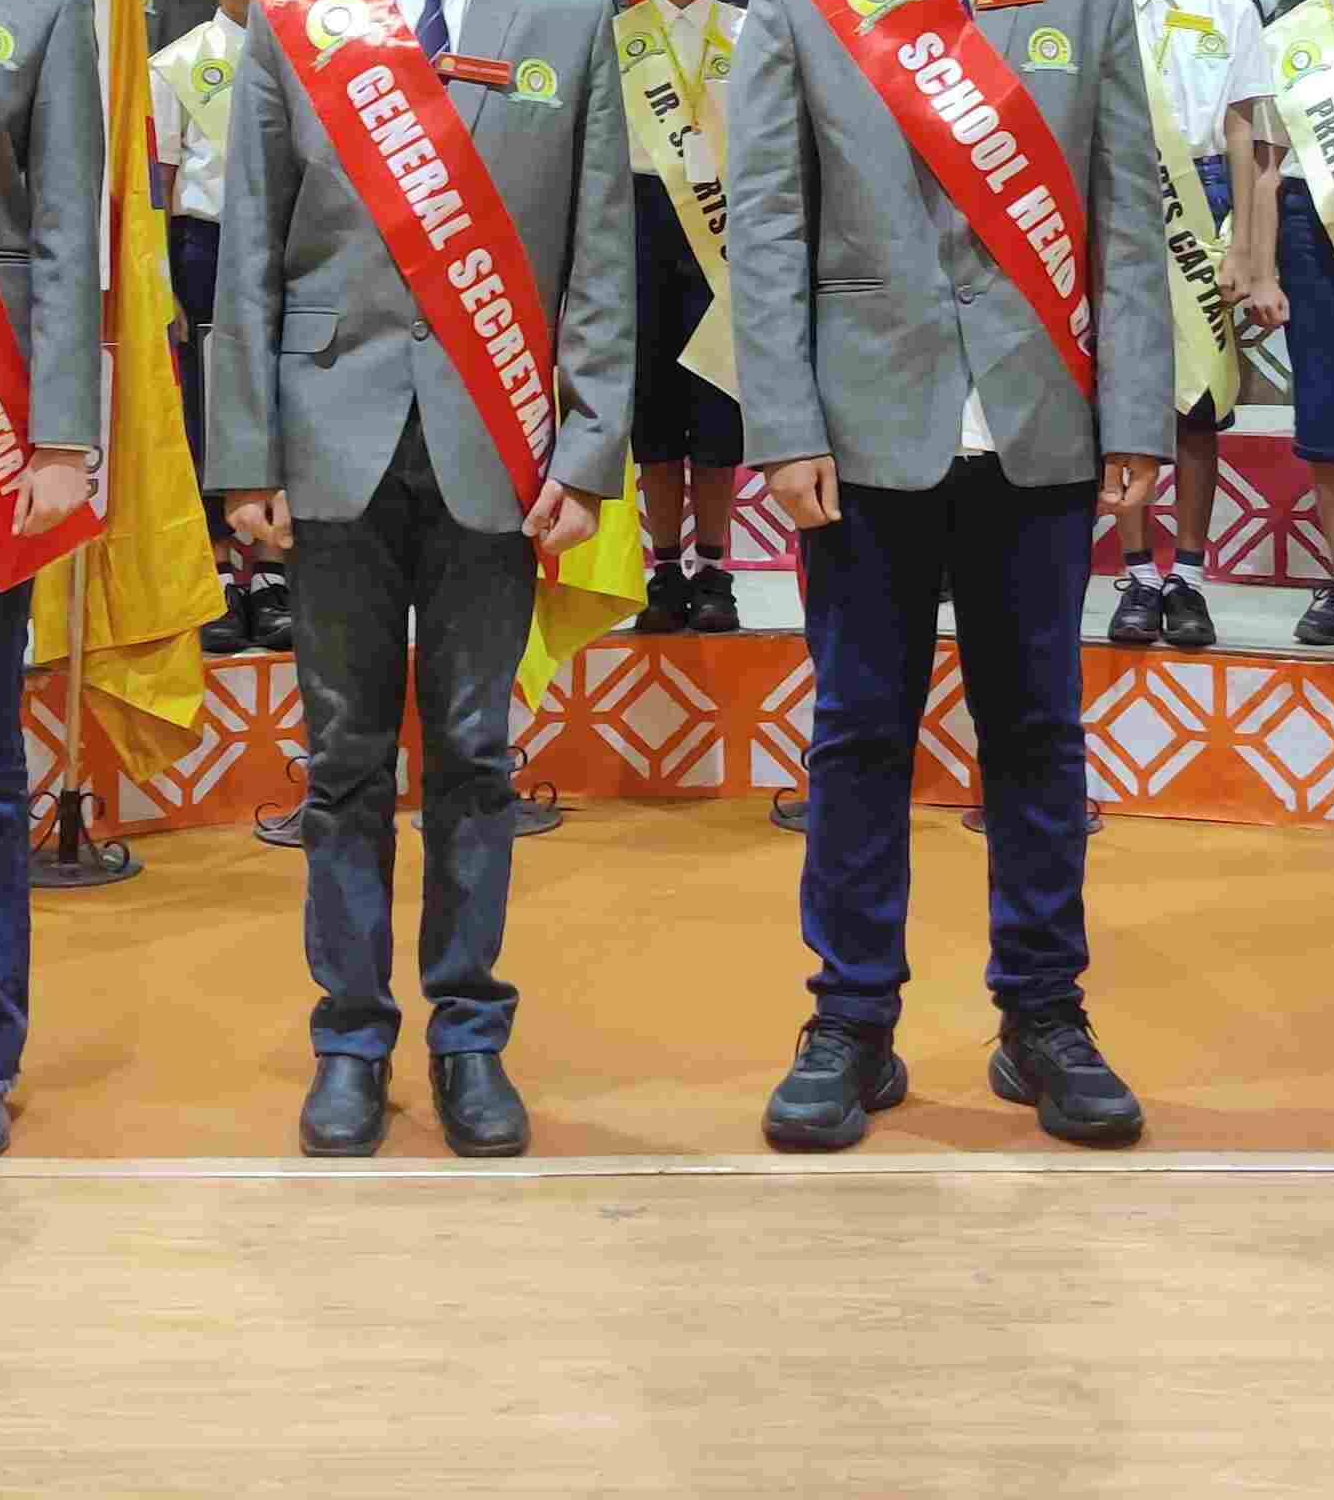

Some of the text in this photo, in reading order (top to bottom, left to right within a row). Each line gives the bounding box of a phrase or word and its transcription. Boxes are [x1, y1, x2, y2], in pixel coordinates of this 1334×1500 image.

[347, 65, 473, 250] GENERAL
[644, 81, 727, 235] JR. SRTS
[897, 31, 1029, 194] SCHOOL
[1005, 184, 1077, 299] HEAD
